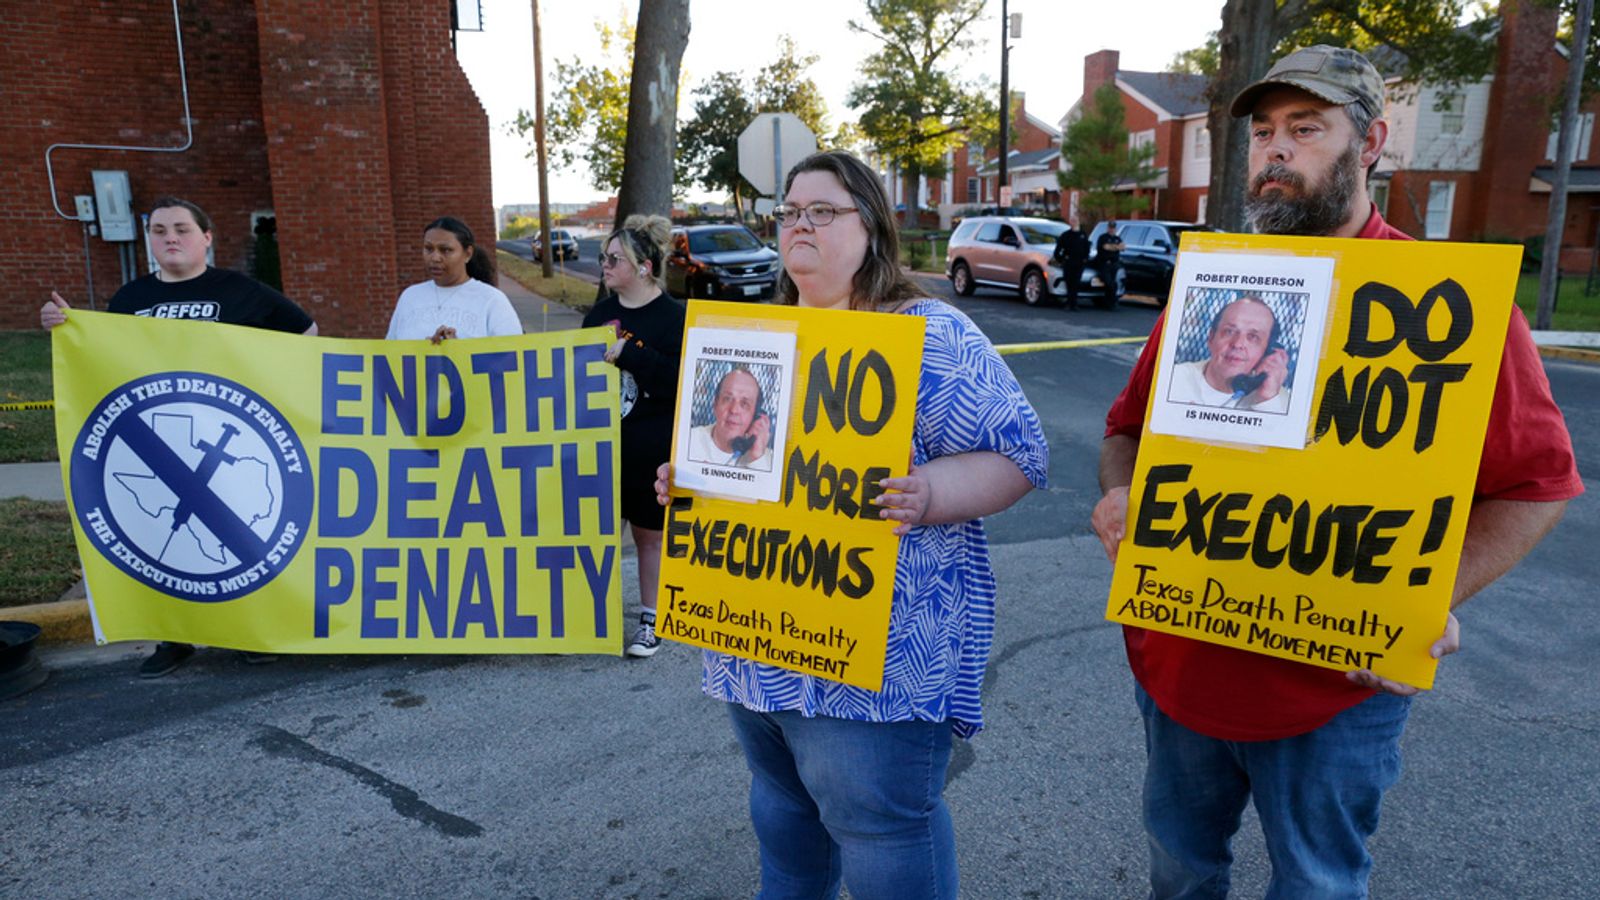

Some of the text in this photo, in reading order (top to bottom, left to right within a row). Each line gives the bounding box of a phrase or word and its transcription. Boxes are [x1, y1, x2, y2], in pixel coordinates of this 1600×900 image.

[155, 304, 214, 318] CEFCO
[1195, 273, 1305, 288] ROBERT ROBERSON
[1342, 278, 1474, 362] DO
[320, 343, 611, 437] END THE
[702, 346, 780, 361] ROBERT ROBERSON
[802, 347, 896, 436] NO
[83, 377, 303, 474] ABOLISH THE DEATH PENALTY
[1185, 409, 1263, 427] IS INNOCENT!
[1314, 363, 1473, 455] NOT
[318, 441, 614, 538] DEATH
[701, 467, 755, 482] IS INNOCENT!
[784, 445, 891, 521] MORE
[86, 507, 300, 595] THE EXECUTIONS MUST STOP
[666, 497, 875, 600] EXECUTIONS
[314, 545, 616, 638] PENALTY
[665, 584, 858, 658] Texas Death Penalty
[1133, 564, 1403, 650] Texas Death Penalty
[661, 613, 849, 679] ABOLITION MOVEMENT
[1117, 598, 1384, 671] ABOLITION MOVEMENT
